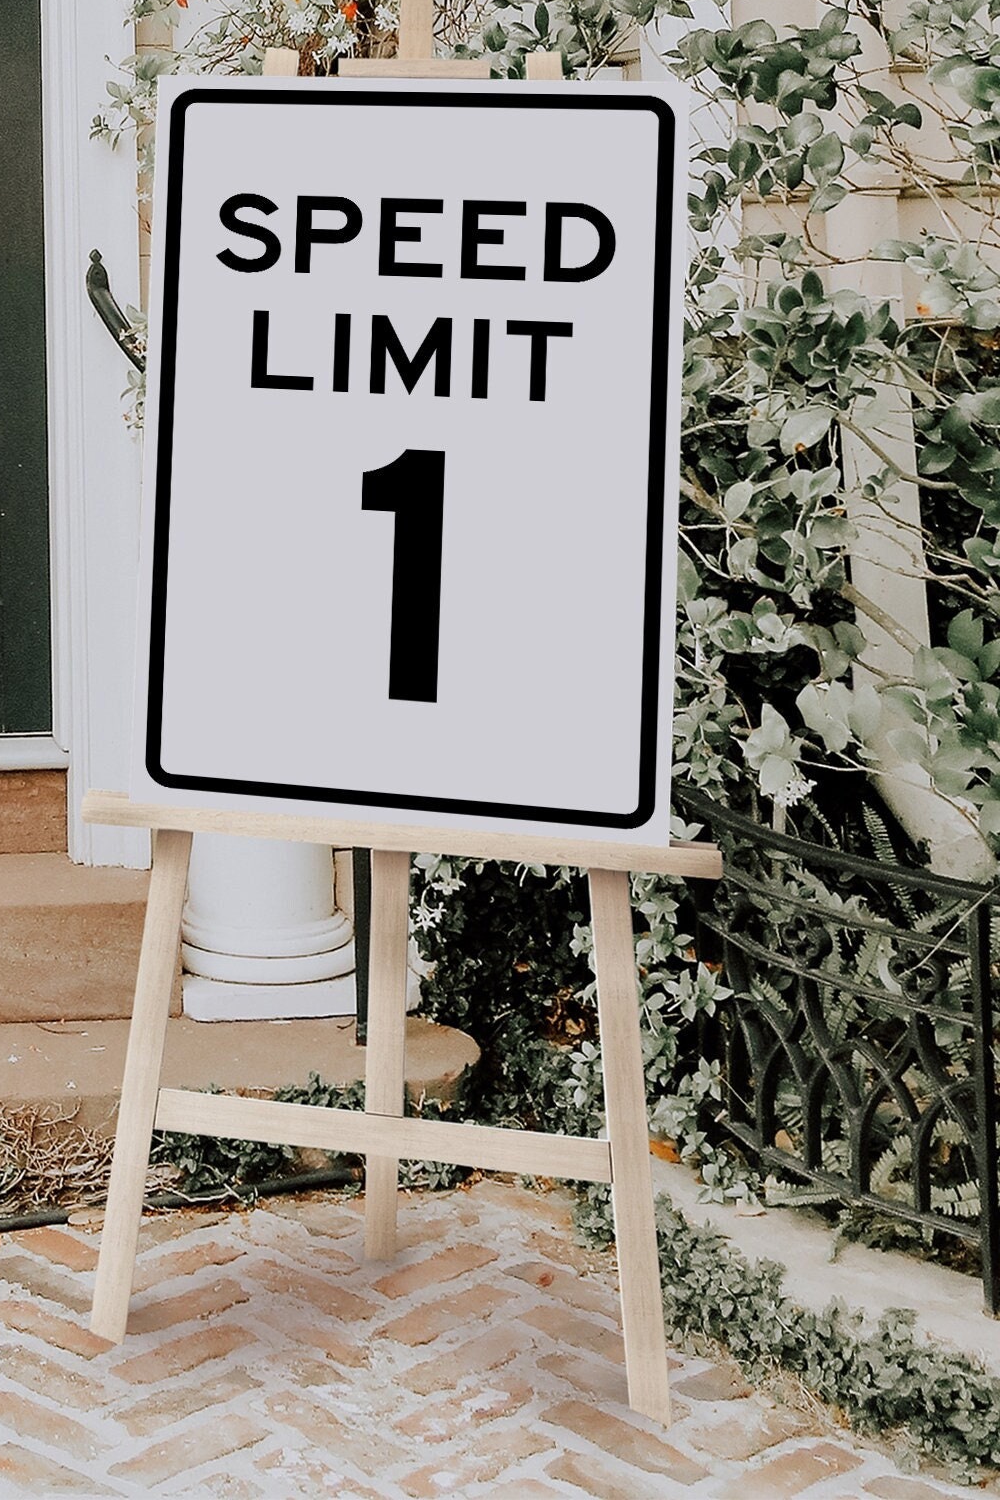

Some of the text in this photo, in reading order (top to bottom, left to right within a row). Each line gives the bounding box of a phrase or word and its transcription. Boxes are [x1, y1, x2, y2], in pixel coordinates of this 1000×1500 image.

[216, 193, 617, 283] SPEED
[250, 309, 574, 402] LIMIT
[361, 448, 446, 704] 1
